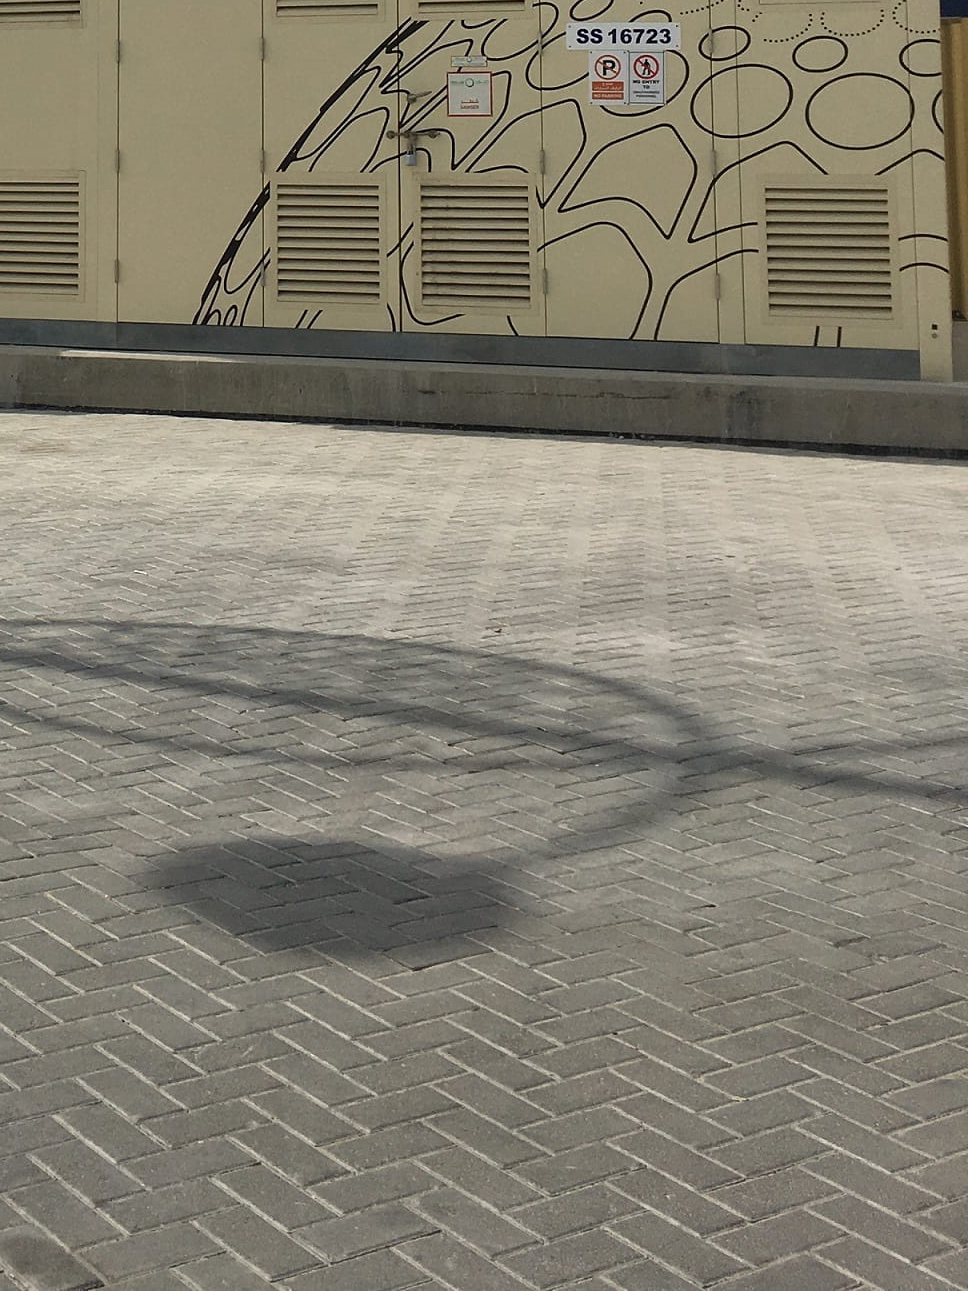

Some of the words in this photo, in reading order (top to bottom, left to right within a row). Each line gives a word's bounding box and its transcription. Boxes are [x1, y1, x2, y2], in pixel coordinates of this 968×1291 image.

[576, 28, 603, 44] SS
[608, 28, 671, 44] 16723
[602, 59, 616, 76] P
